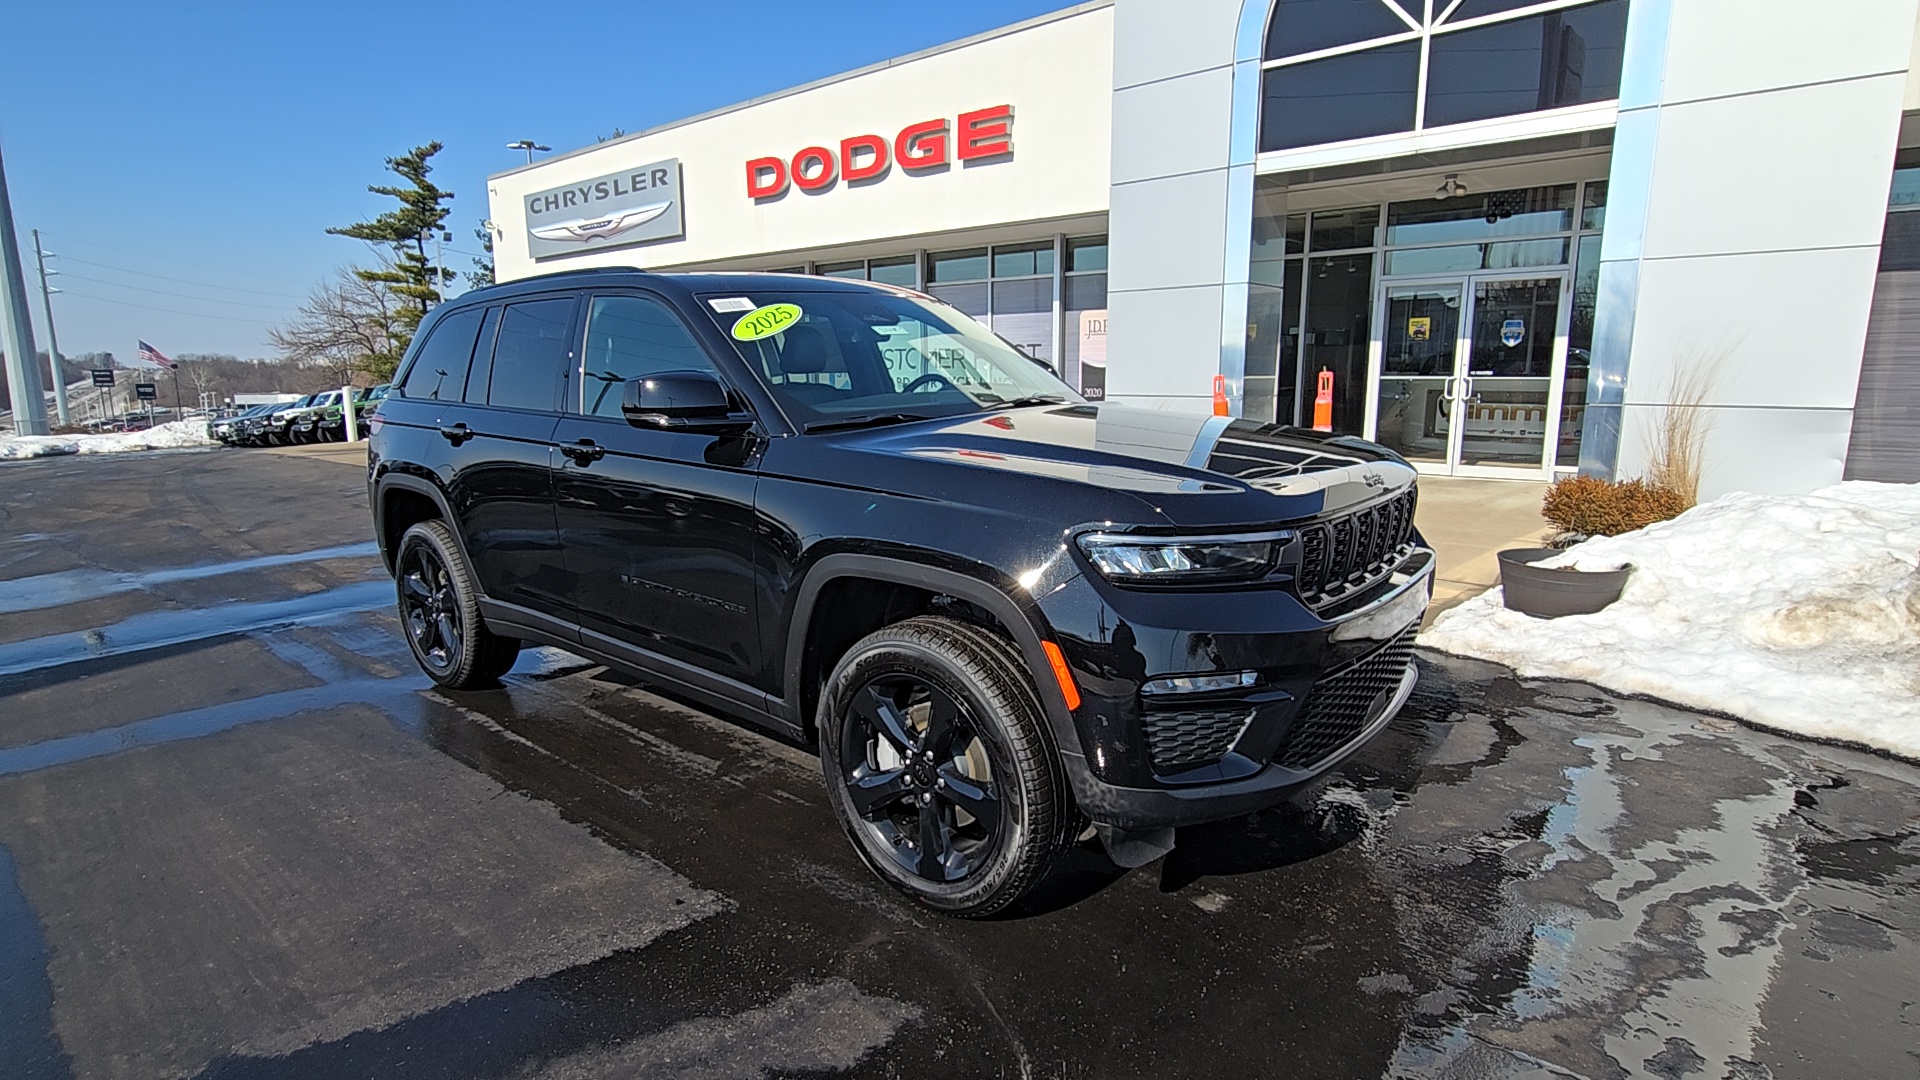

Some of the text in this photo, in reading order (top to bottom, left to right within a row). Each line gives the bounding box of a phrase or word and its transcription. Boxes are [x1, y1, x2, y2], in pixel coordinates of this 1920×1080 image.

[746, 104, 1012, 198] DODGE
[530, 168, 668, 214] CHRYSLER
[745, 306, 793, 336] 2025
[1083, 387, 1103, 398] 2020
